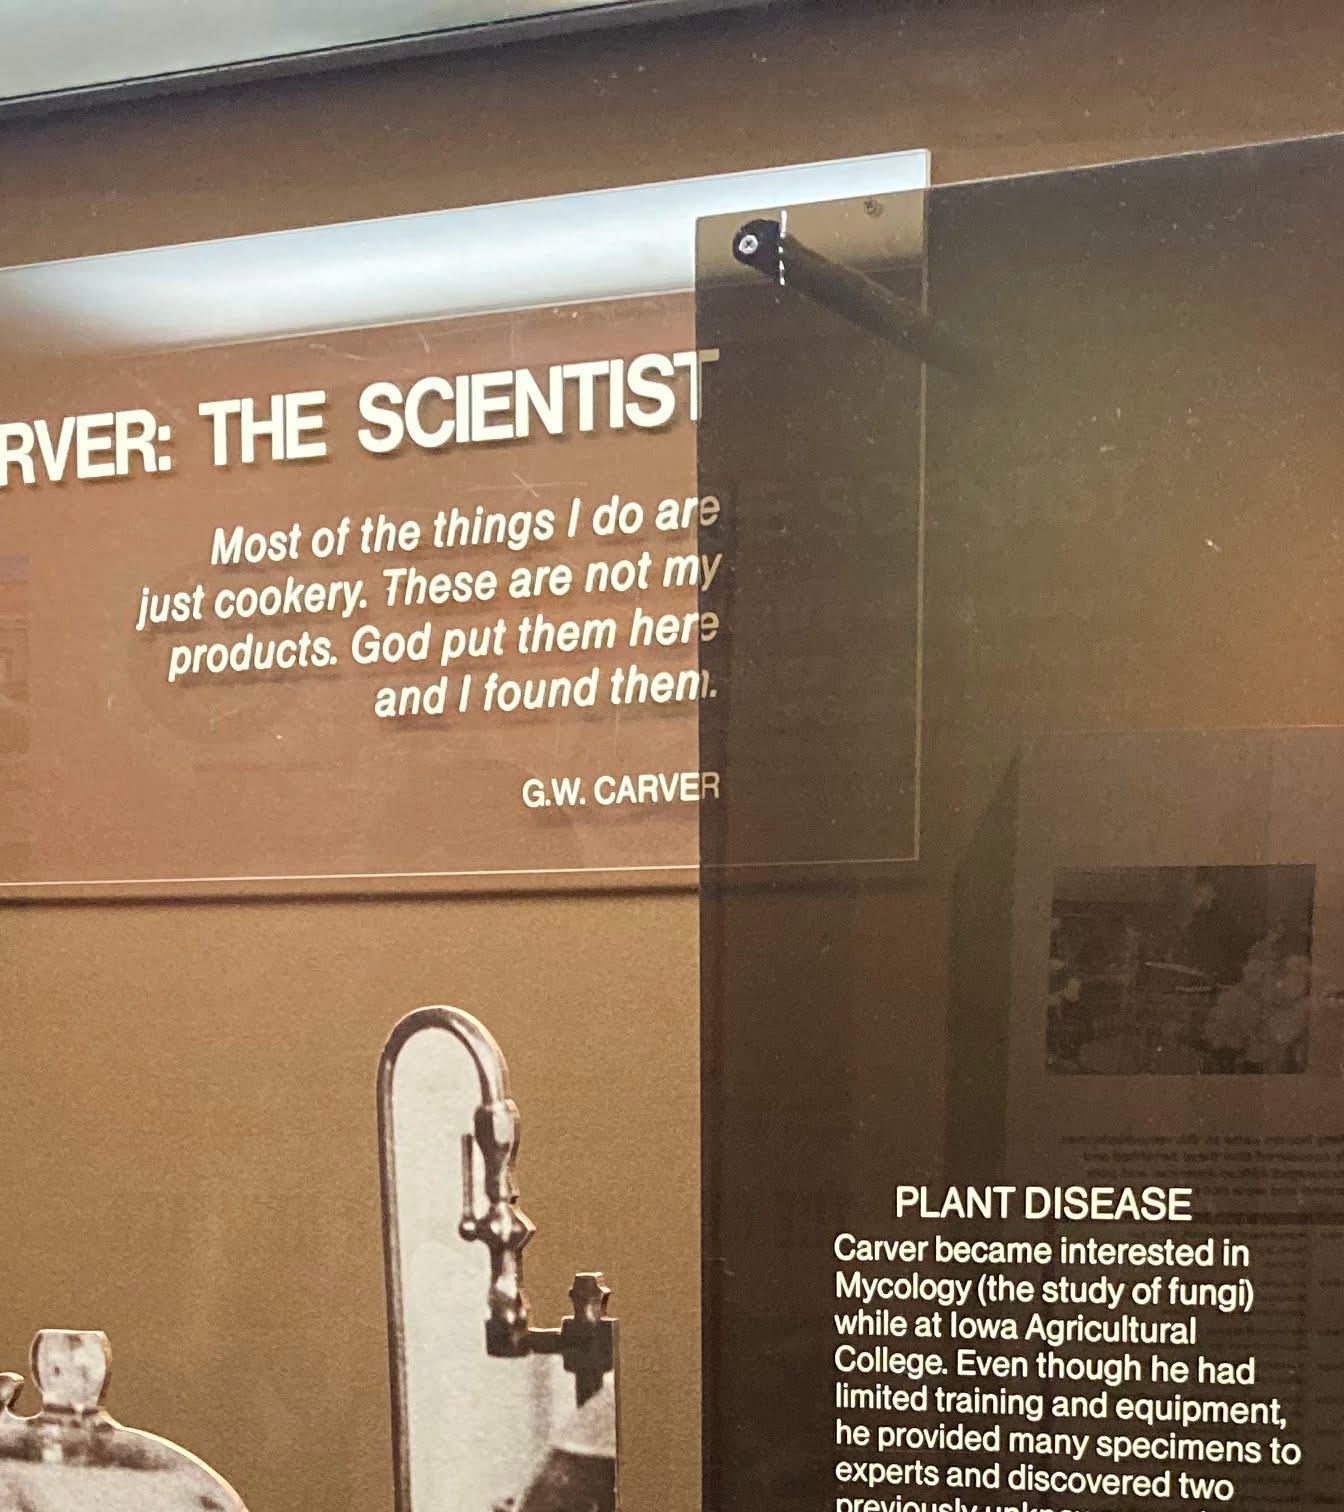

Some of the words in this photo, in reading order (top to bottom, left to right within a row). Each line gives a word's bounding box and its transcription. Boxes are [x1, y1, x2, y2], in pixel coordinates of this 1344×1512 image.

[198, 390, 327, 466] THE
[358, 348, 720, 454] SCIENTIST
[211, 523, 302, 565] Most
[312, 517, 350, 558] of
[361, 514, 421, 553] the
[433, 506, 555, 551] things
[567, 498, 581, 537] I
[592, 494, 644, 536] do
[655, 494, 720, 531] are
[136, 585, 204, 631] just
[214, 576, 367, 618] cookery.
[383, 567, 497, 605] These
[508, 564, 572, 598] are
[584, 552, 652, 592] not
[662, 553, 722, 591] my
[168, 632, 337, 682] products.
[351, 622, 432, 664] God
[441, 619, 506, 666] put
[518, 614, 617, 654] them
[629, 608, 720, 646] here
[374, 676, 448, 717] and
[459, 674, 471, 712] I
[484, 667, 599, 712] found
[610, 664, 716, 704] them.
[522, 777, 585, 807] G.W.
[594, 772, 720, 805] CARVER
[897, 1186, 1016, 1218] PLANT
[1026, 1186, 1192, 1220] DISEASE
[835, 1233, 928, 1261] Carver
[936, 1235, 1052, 1264] became
[1061, 1237, 1214, 1266] interested
[1224, 1239, 1249, 1266] in
[837, 1271, 972, 1306] Mycology
[978, 1274, 1034, 1306] (the
[1042, 1276, 1125, 1309] study
[1132, 1277, 1161, 1304] of
[1168, 1277, 1253, 1312] fungi)
[834, 1309, 907, 1336] while
[915, 1312, 942, 1337] at
[951, 1311, 1018, 1339] Iowa
[1025, 1313, 1196, 1346] Agricultural
